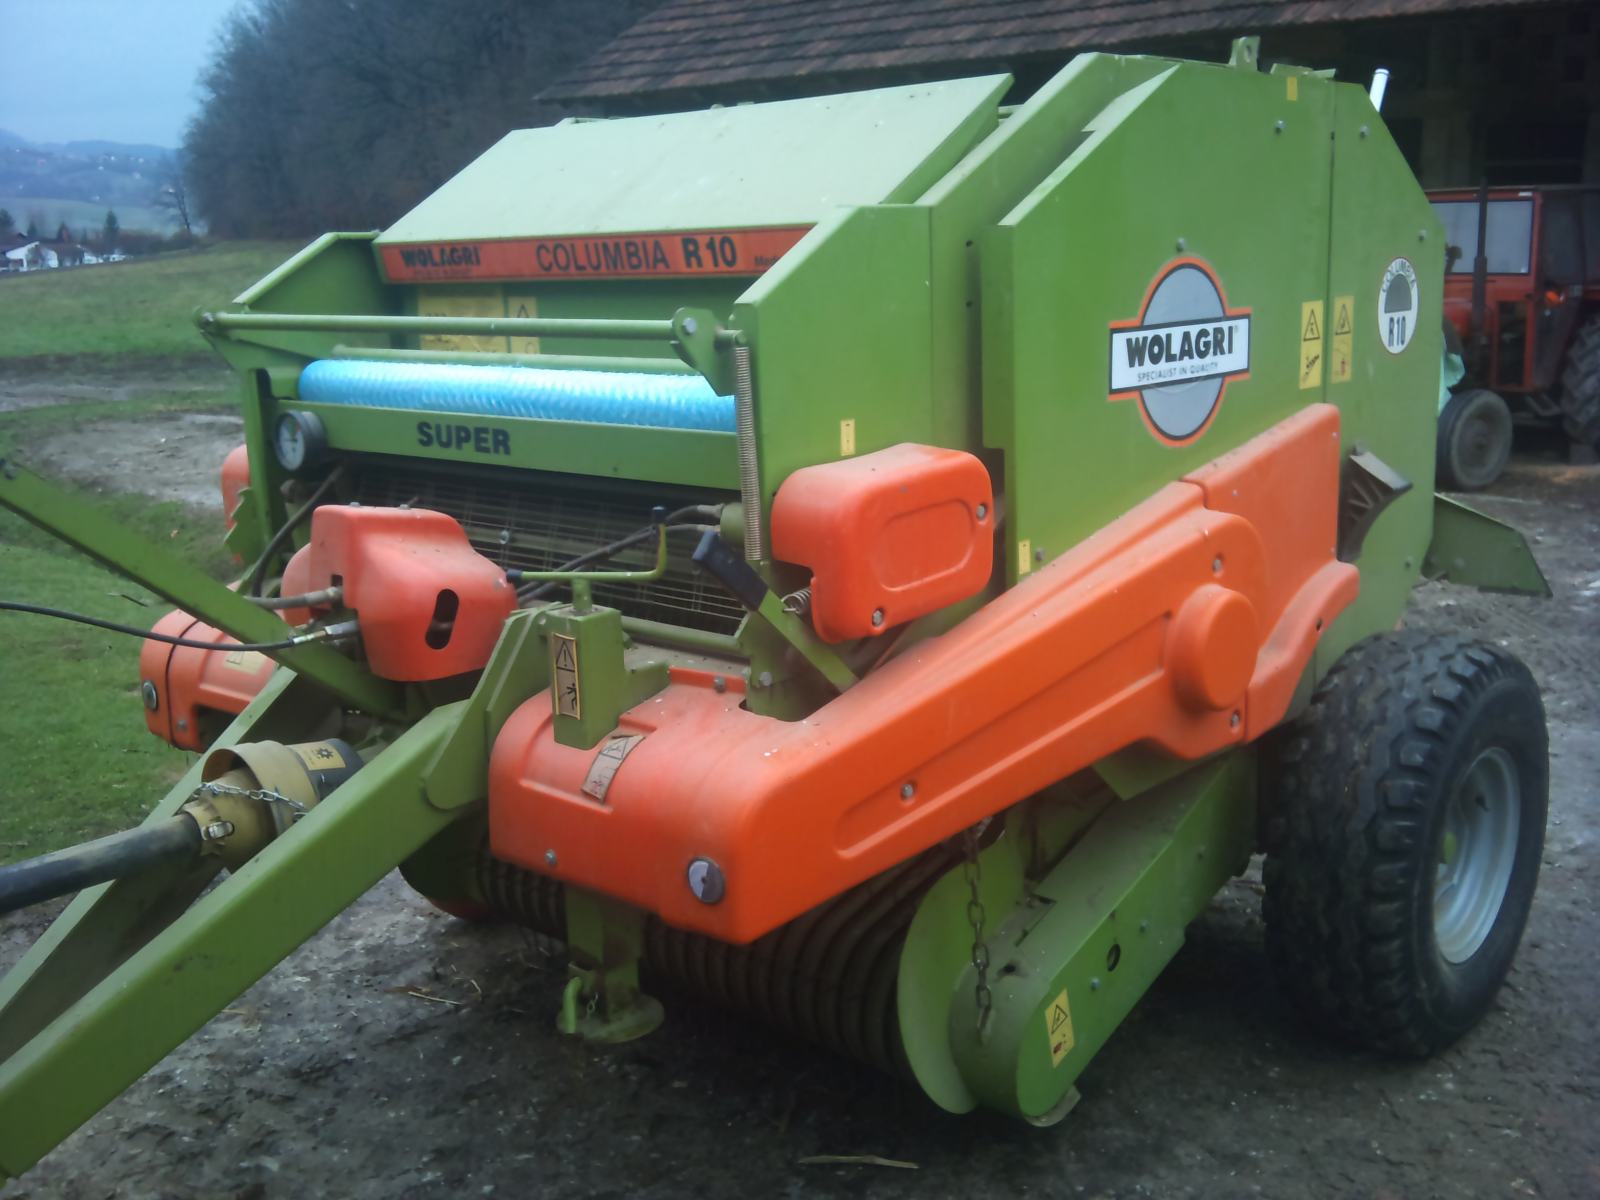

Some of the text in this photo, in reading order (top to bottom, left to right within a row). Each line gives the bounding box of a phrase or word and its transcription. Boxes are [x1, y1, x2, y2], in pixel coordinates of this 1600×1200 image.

[401, 246, 481, 267] WOLAGRI
[536, 240, 670, 272] COLUMBIA
[1137, 361, 1218, 382] SPECIALIST IN QUALITY
[417, 421, 511, 456] SUPER
